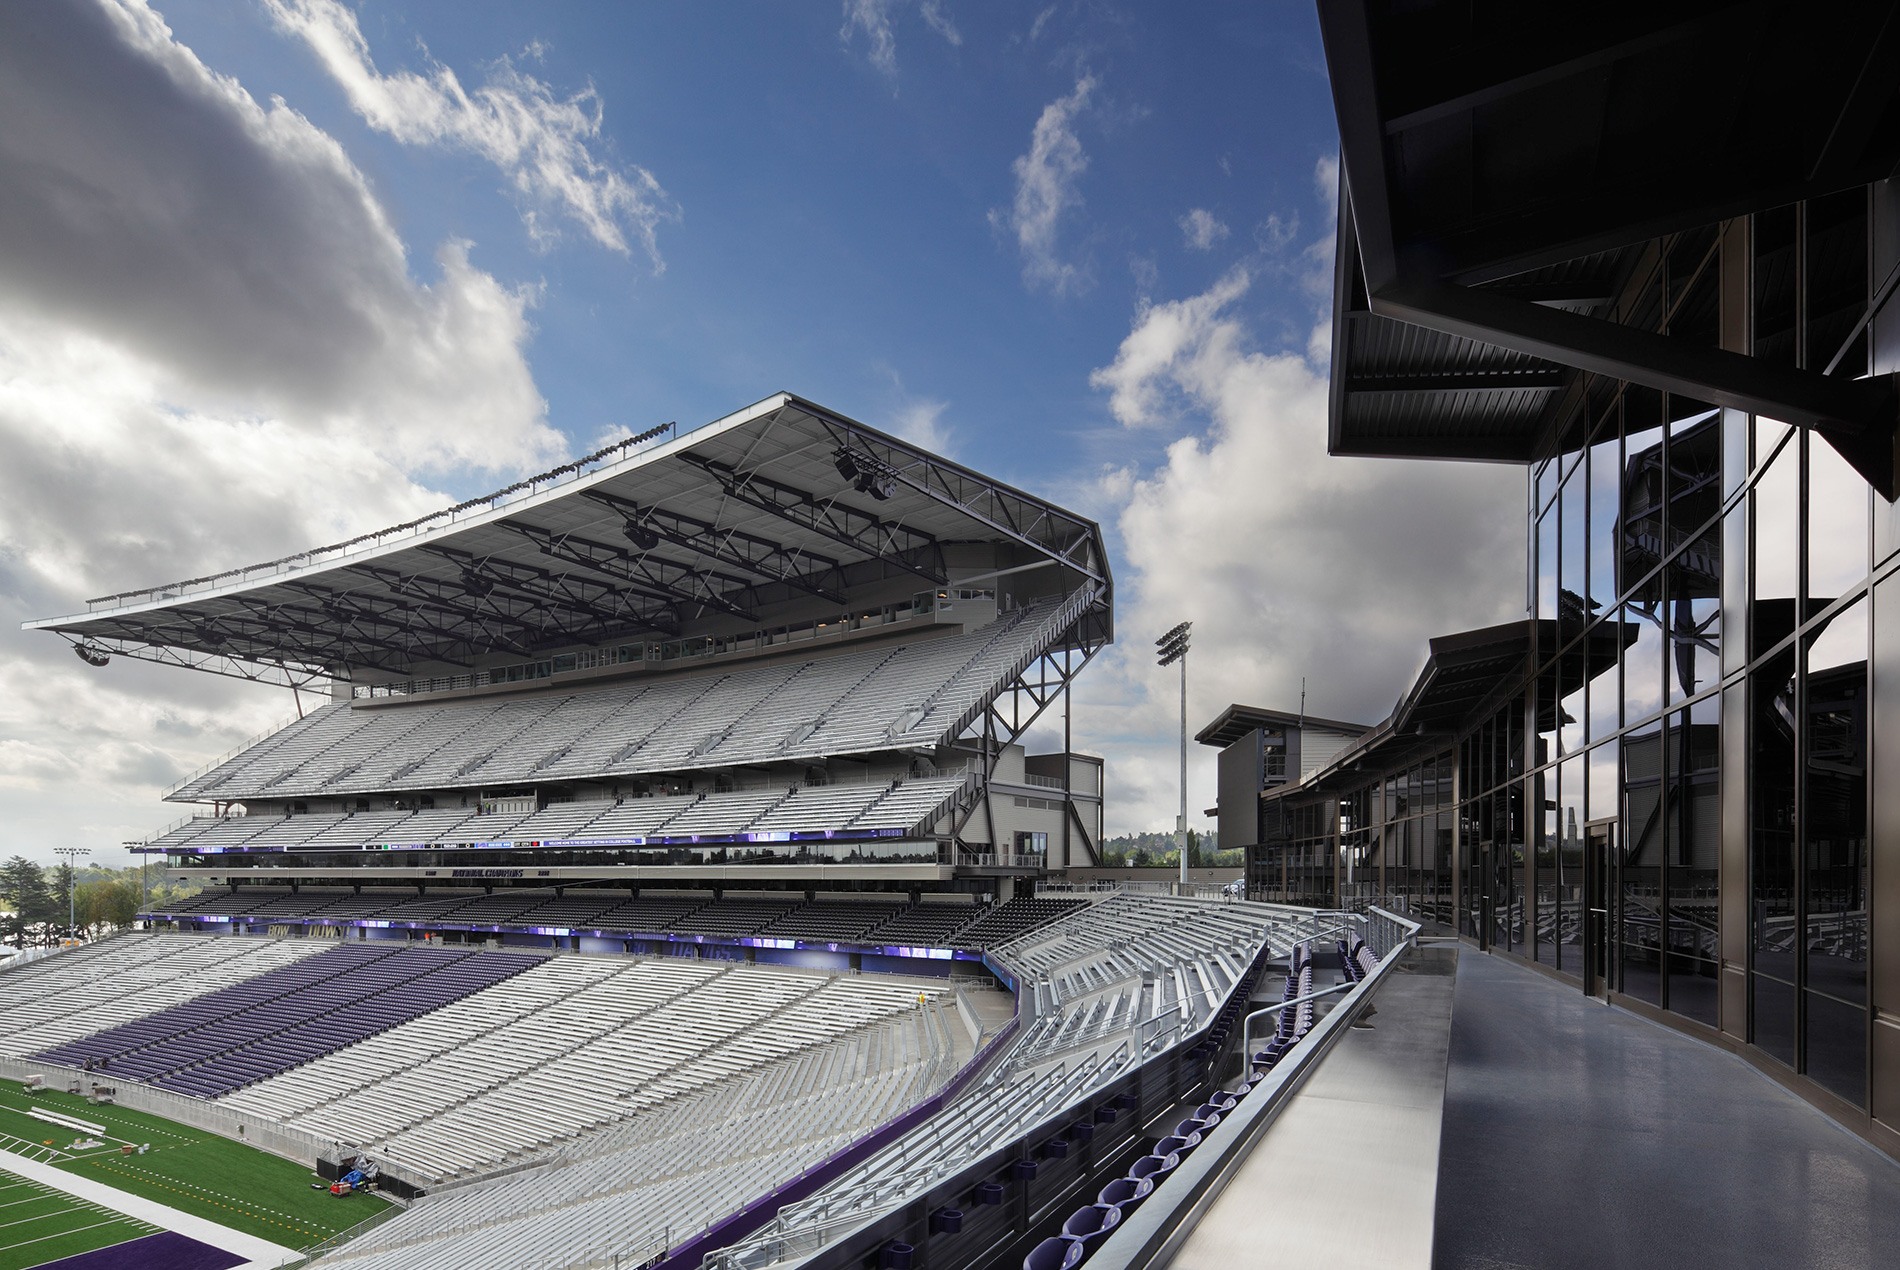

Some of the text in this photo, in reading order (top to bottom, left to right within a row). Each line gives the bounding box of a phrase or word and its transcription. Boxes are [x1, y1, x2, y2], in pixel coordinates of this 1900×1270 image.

[452, 869, 523, 877] NATIONAL CHAMPIONS
[268, 925, 289, 936] BOW
[646, 1257, 656, 1269] 217
